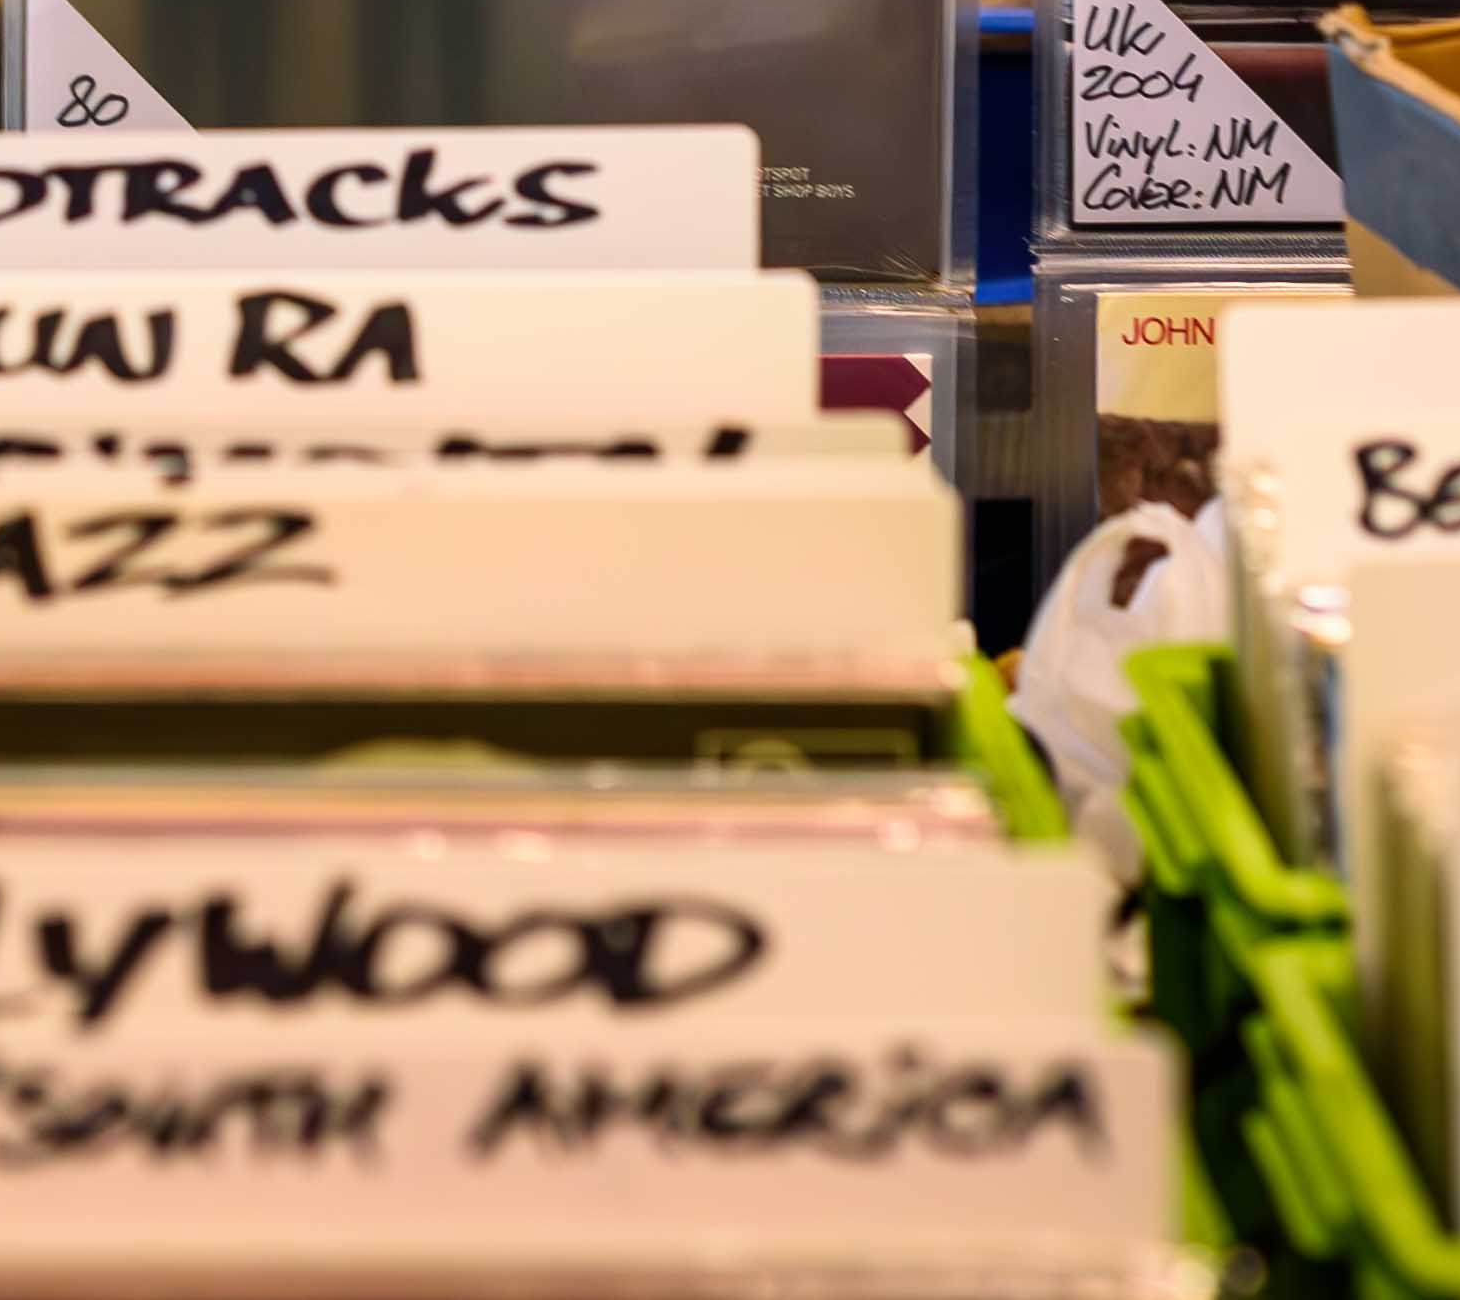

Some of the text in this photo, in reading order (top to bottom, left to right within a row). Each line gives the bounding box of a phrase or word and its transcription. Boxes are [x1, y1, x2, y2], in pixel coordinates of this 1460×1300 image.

[57, 74, 130, 128] 80
[1079, 64, 1204, 106] 2004
[1203, 118, 1279, 161] NM
[1208, 162, 1293, 206] NM
[224, 289, 428, 387] RA
[1121, 315, 1217, 346] JOHN
